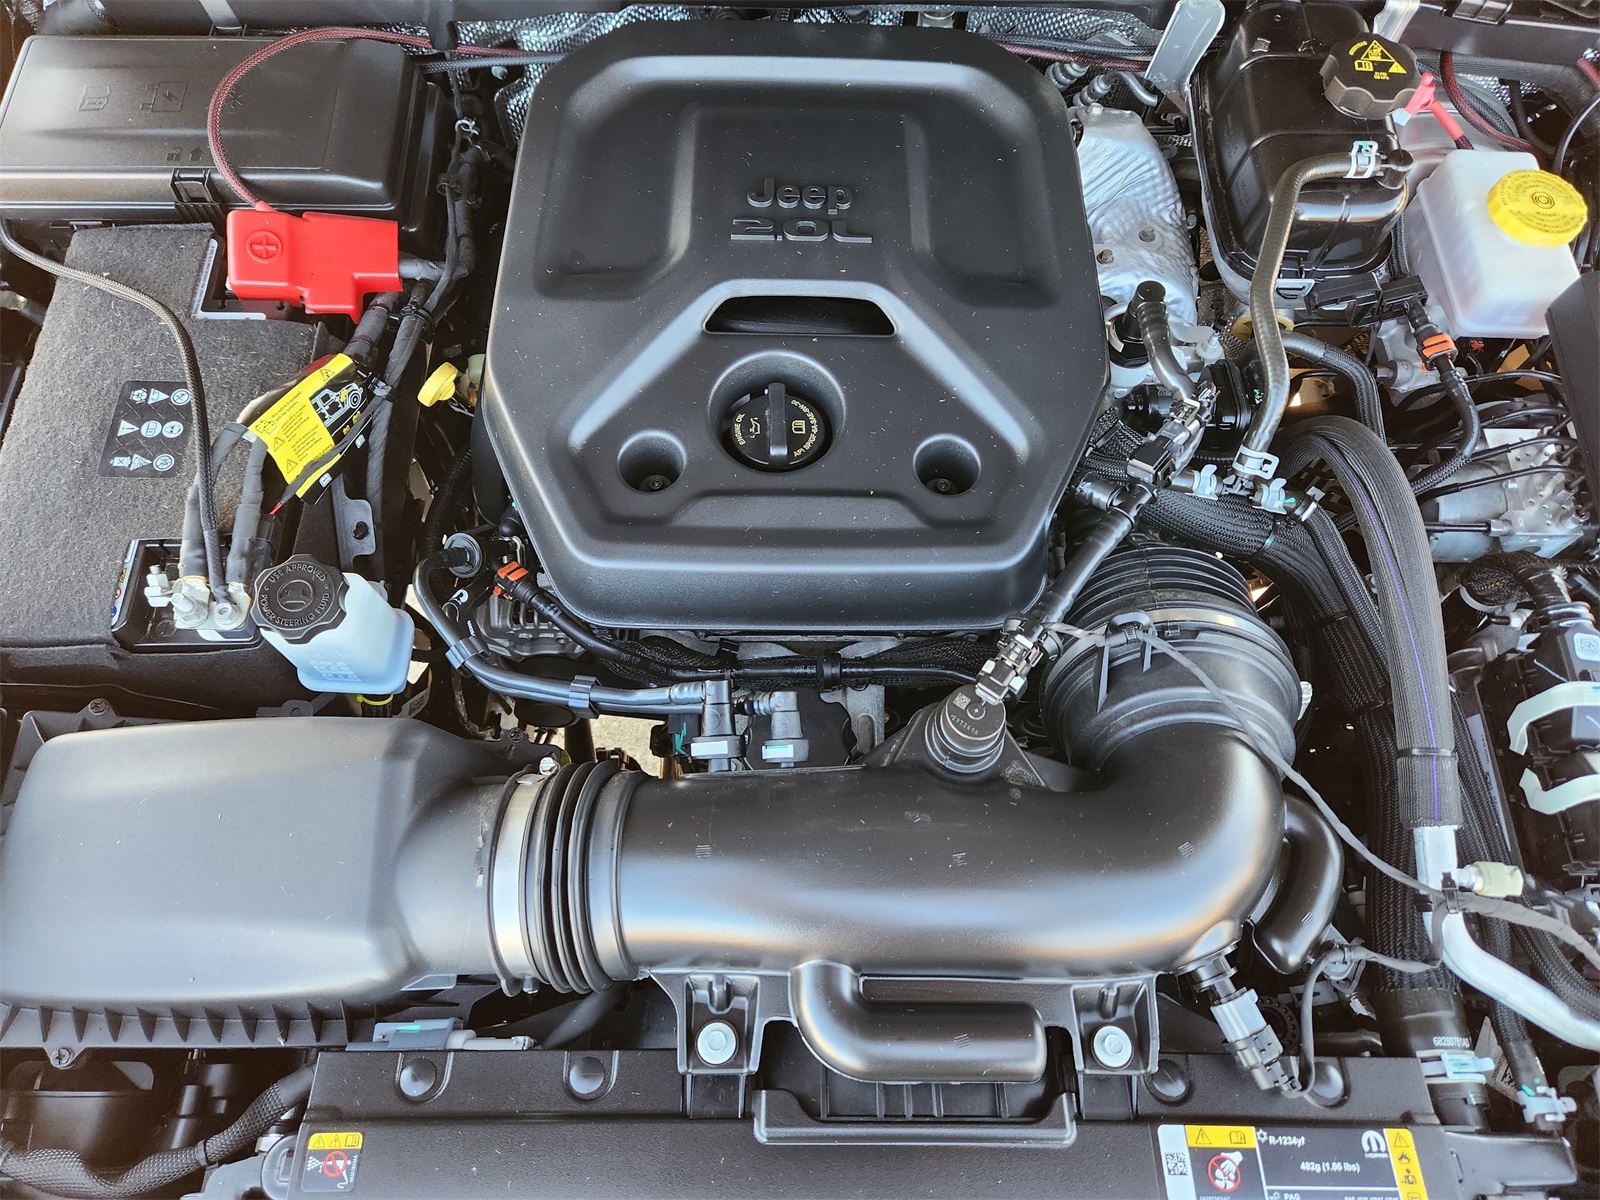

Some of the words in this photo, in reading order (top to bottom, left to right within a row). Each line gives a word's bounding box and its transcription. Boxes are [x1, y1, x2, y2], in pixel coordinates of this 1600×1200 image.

[747, 177, 852, 214] Jeep
[731, 218, 872, 243] 2.0L
[736, 414, 746, 422] OIL
[734, 423, 746, 446] ENGINE
[794, 448, 806, 458] API
[268, 570, 284, 582] USE
[286, 564, 326, 581] APPROVED
[260, 594, 276, 620] POWER
[275, 612, 316, 626] STEERING
[315, 592, 330, 614] FLUID
[1300, 1160, 1320, 1174] 482g
[1322, 1160, 1342, 1174] (1.06
[1343, 1160, 1360, 1174] lbs)
